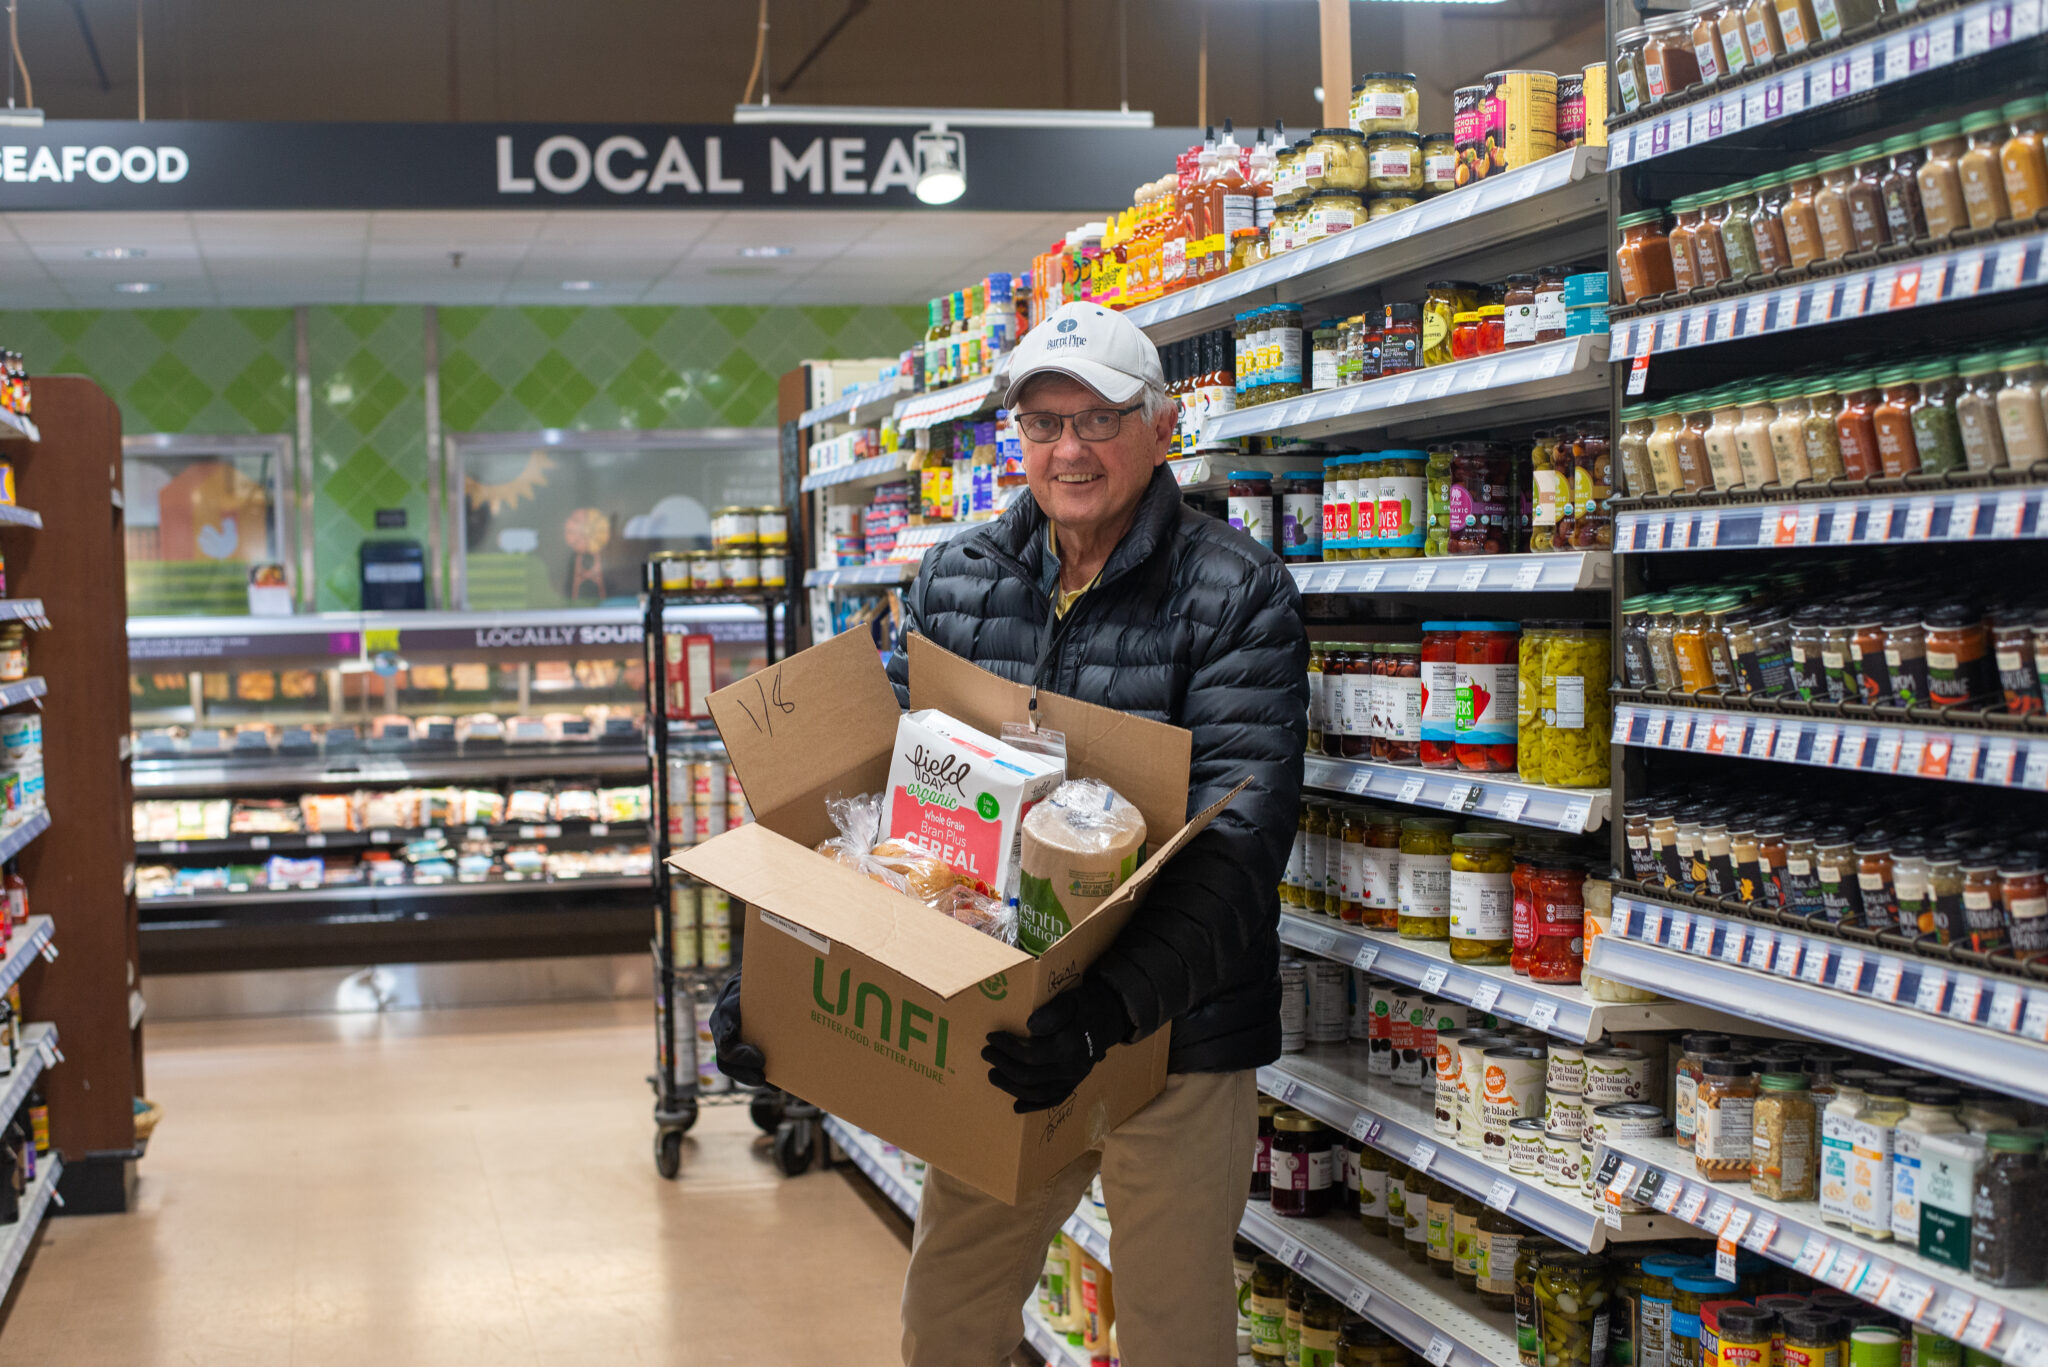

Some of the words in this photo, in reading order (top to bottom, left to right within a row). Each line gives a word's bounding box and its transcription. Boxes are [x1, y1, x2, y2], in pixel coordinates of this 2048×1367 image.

[0, 146, 189, 183] EAFOOD
[497, 135, 743, 194] LOCAL
[1069, 334, 1087, 348] Pine
[1633, 360, 1643, 368] Sale
[476, 626, 574, 647] LOCALLY
[905, 745, 971, 798] field
[921, 771, 947, 792] DAY
[906, 783, 958, 811] organic
[924, 809, 945, 827] Whole
[946, 817, 965, 832] Grain
[920, 821, 944, 838] Bran
[946, 830, 967, 847] Plus
[812, 957, 949, 1070] UNFI
[810, 1010, 843, 1035] BETTER
[844, 1026, 871, 1049] FOOD.
[873, 1041, 906, 1068] BETTER
[908, 1058, 946, 1086] FUTURE.
[1550, 1064, 1562, 1074] ripe
[1564, 1064, 1583, 1075] blac
[1555, 1073, 1579, 1082] olives
[1589, 1074, 1605, 1084] ripe
[1606, 1074, 1631, 1084] black
[1596, 1082, 1622, 1092] olives
[1491, 1105, 1519, 1116] black
[1553, 1109, 1568, 1119] ripe
[1484, 1115, 1507, 1126] olives
[1521, 1143, 1544, 1153] black
[1514, 1151, 1534, 1161] olives
[1548, 1153, 1567, 1164] black
[1606, 1191, 1616, 1201] Sale
[1726, 1348, 1757, 1359] BRAGG
